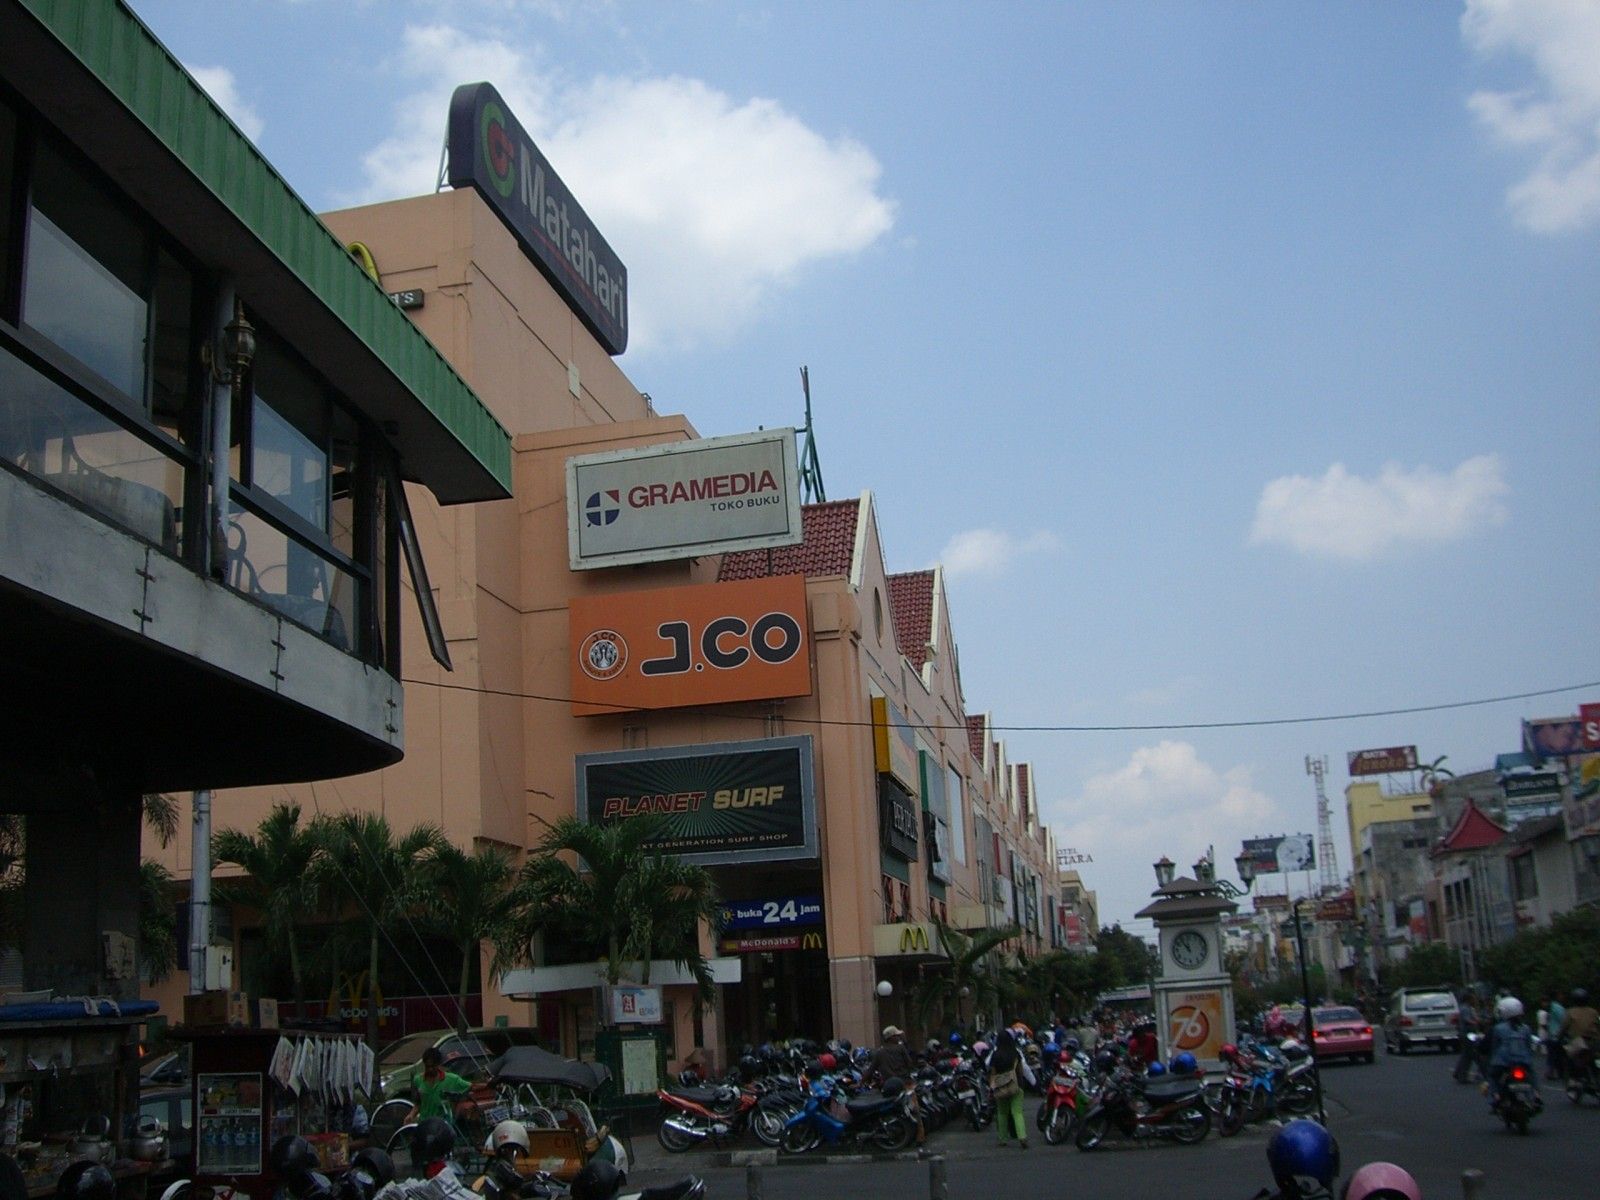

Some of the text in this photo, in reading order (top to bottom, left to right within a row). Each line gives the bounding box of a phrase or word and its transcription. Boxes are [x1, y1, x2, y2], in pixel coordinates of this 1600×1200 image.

[520, 142, 624, 328] Matahari
[627, 470, 778, 509] GRAMEDIA
[710, 495, 780, 512] TOKO BUKU
[640, 611, 802, 676] J.CO
[603, 785, 785, 819] PLANET SURF
[759, 832, 788, 841] SHOP
[1055, 847, 1077, 855] OTEL
[737, 908, 763, 919] buka
[763, 899, 798, 923] 24
[740, 936, 796, 948] McDonald's
[1169, 1008, 1202, 1047] 76
